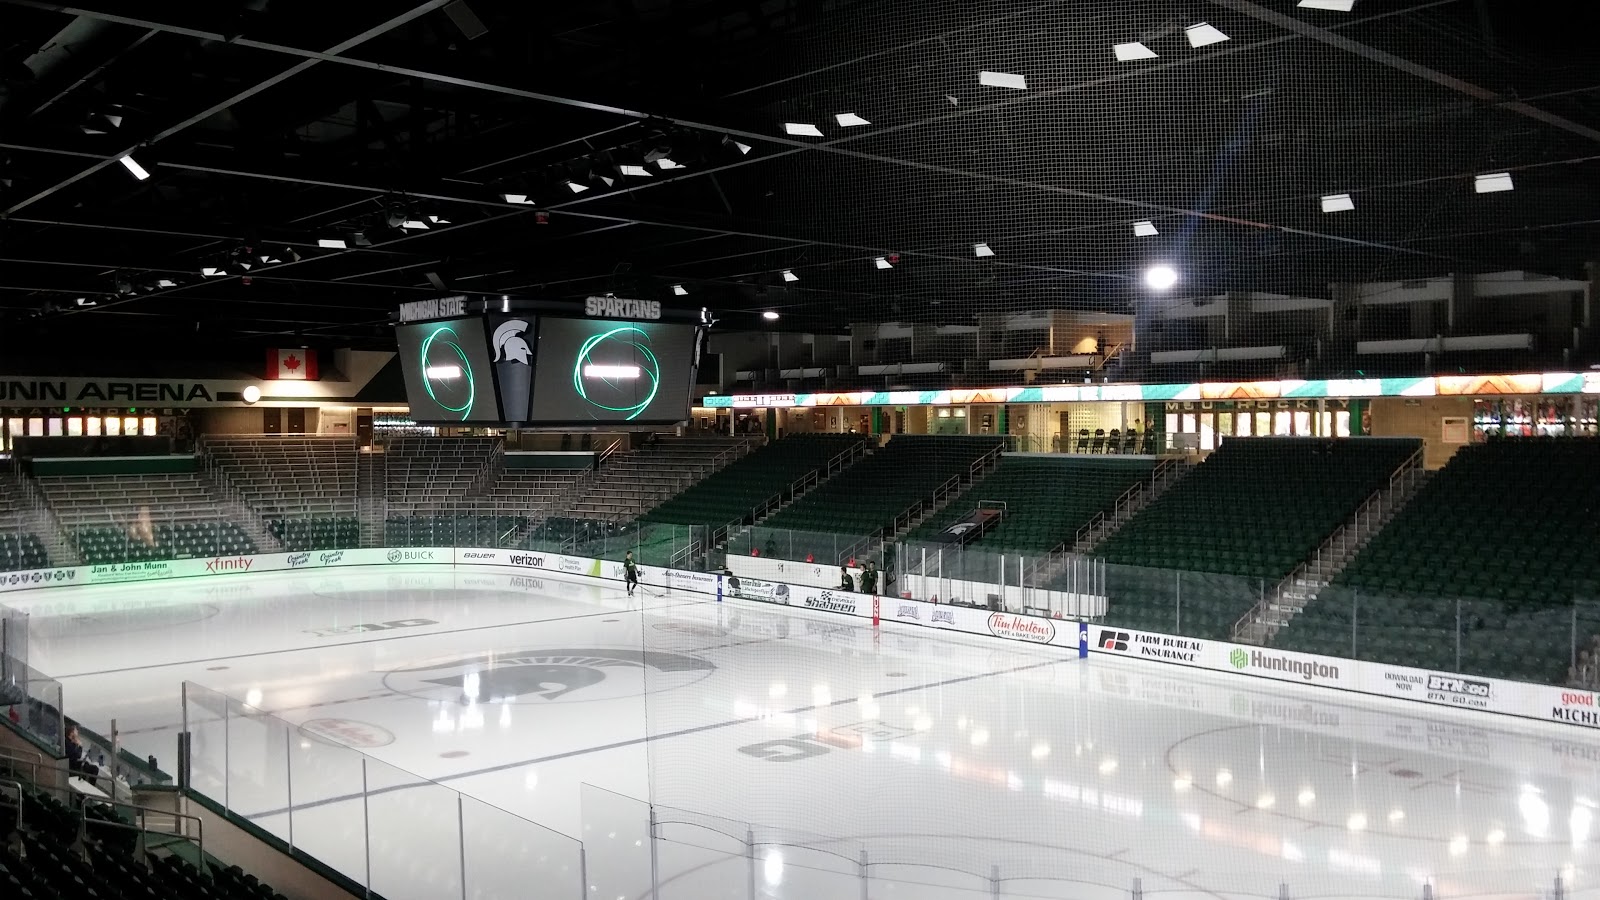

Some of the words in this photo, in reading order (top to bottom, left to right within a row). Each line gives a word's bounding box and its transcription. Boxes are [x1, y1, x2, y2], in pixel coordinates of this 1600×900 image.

[399, 299, 439, 322] MICHIGAN
[439, 295, 468, 317] STATE
[585, 296, 661, 320] SPARTANS
[0, 381, 66, 401] NN
[76, 382, 213, 402] ARENA
[0, 407, 62, 416] TAN
[404, 551, 434, 560] BUICK
[509, 553, 543, 567] verizon
[91, 565, 108, 574] Jan
[110, 564, 117, 572] &
[120, 563, 142, 571] John
[144, 562, 168, 570] Munn
[205, 556, 254, 573] xfinity
[804, 596, 856, 613] Shaheen
[993, 614, 1011, 630] Tim
[1015, 631, 1030, 639] BAKE
[1134, 634, 1161, 645] FARM
[1162, 637, 1204, 652] BUREAU
[1141, 646, 1197, 662] INSURANCE
[1251, 650, 1340, 680] Huntington
[1384, 671, 1424, 685] DOWNLOAD
[1395, 682, 1413, 691] NOW
[1561, 692, 1594, 707] good
[1552, 706, 1600, 725] MICHI
